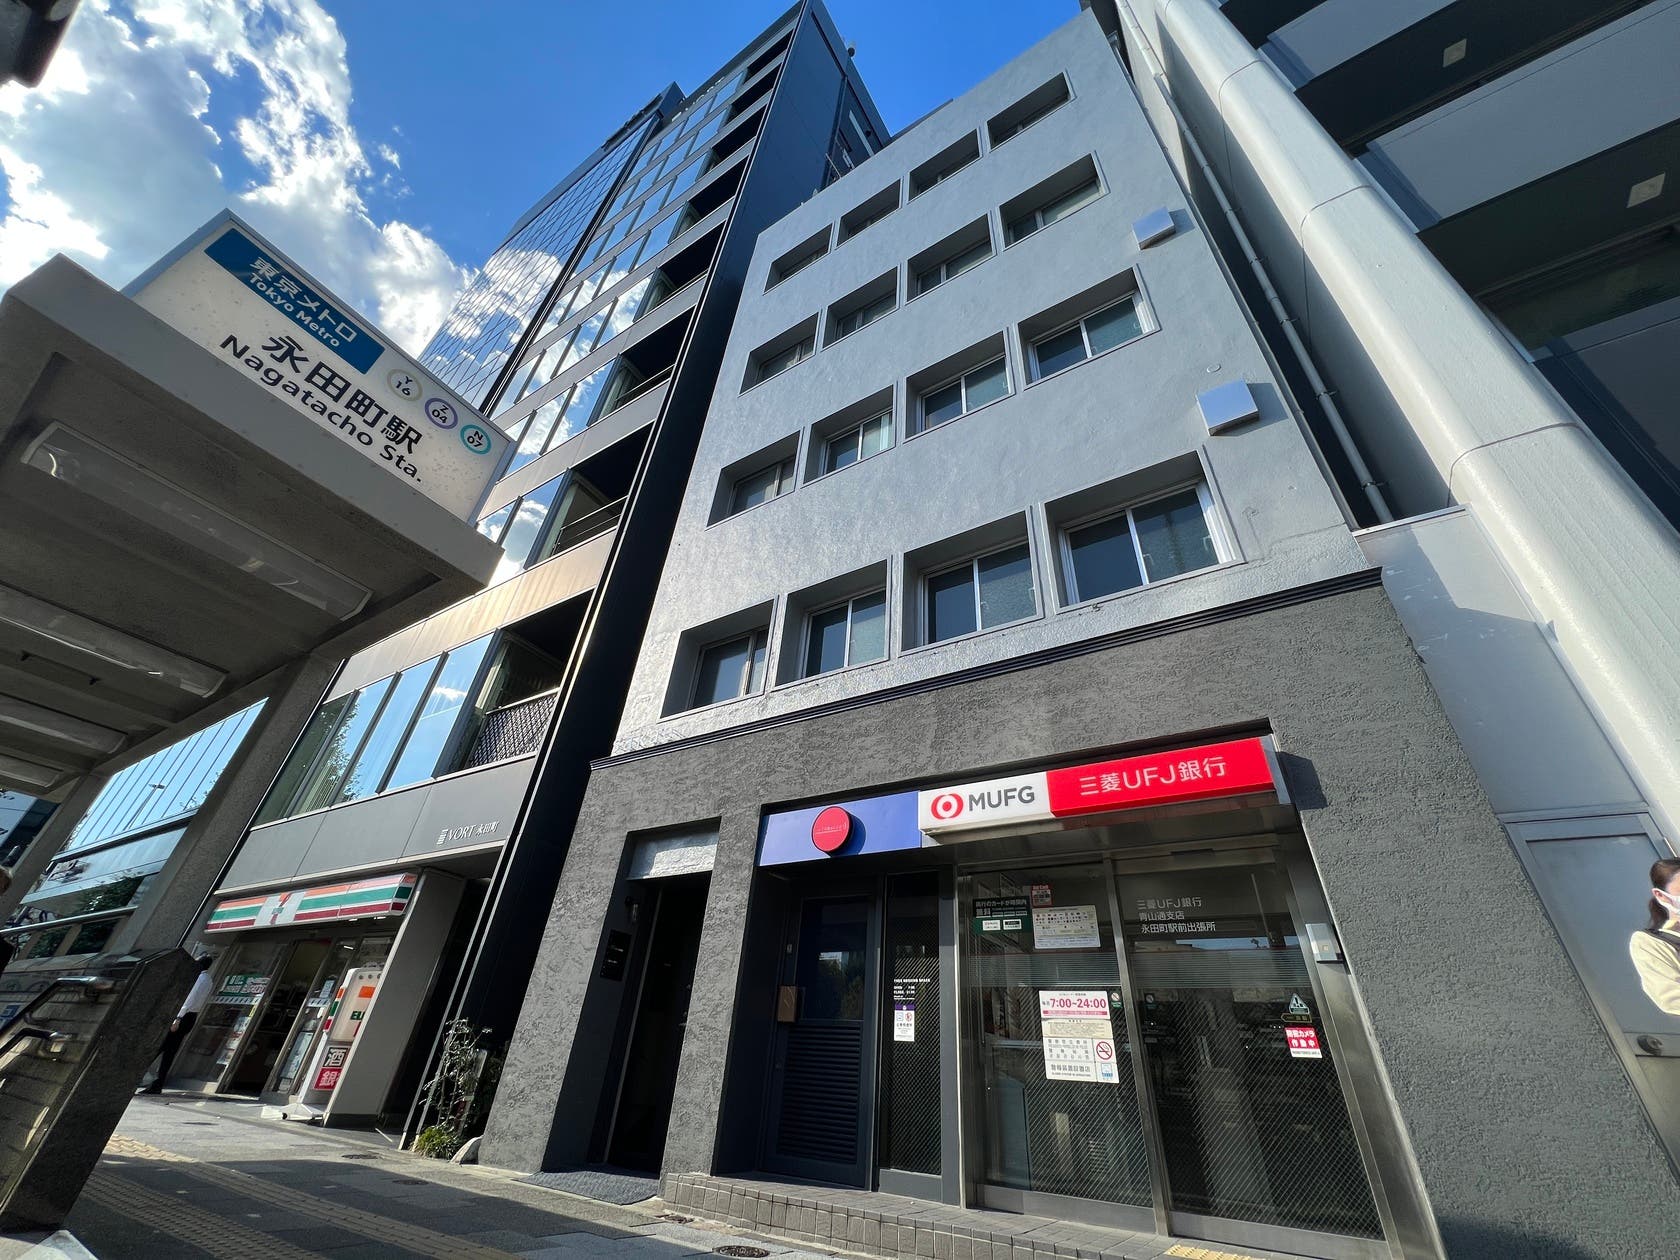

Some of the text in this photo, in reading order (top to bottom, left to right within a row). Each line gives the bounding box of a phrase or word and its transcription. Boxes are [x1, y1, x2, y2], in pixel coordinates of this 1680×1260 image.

[250, 256, 357, 342] 東京メトロ
[249, 272, 340, 347] Tokyo Metro
[396, 380, 411, 396] 16
[405, 376, 413, 385] Y
[261, 335, 423, 454] 永田町駅
[219, 334, 422, 483] Nagatacho Sta.
[432, 409, 448, 424] 04
[440, 404, 449, 414] Z
[466, 435, 483, 448] 07
[474, 430, 483, 441] N
[1079, 756, 1226, 797] 三菱UFJ銀行
[968, 785, 1035, 812] MUFG
[448, 824, 477, 841] VORT
[1137, 896, 1202, 910] 三菱UFJ銀行
[1139, 911, 1185, 921] 青山通支店
[1141, 922, 1216, 934] 永田町駅前出張所
[324, 1048, 347, 1067] 酒
[319, 1071, 342, 1087] 銀
